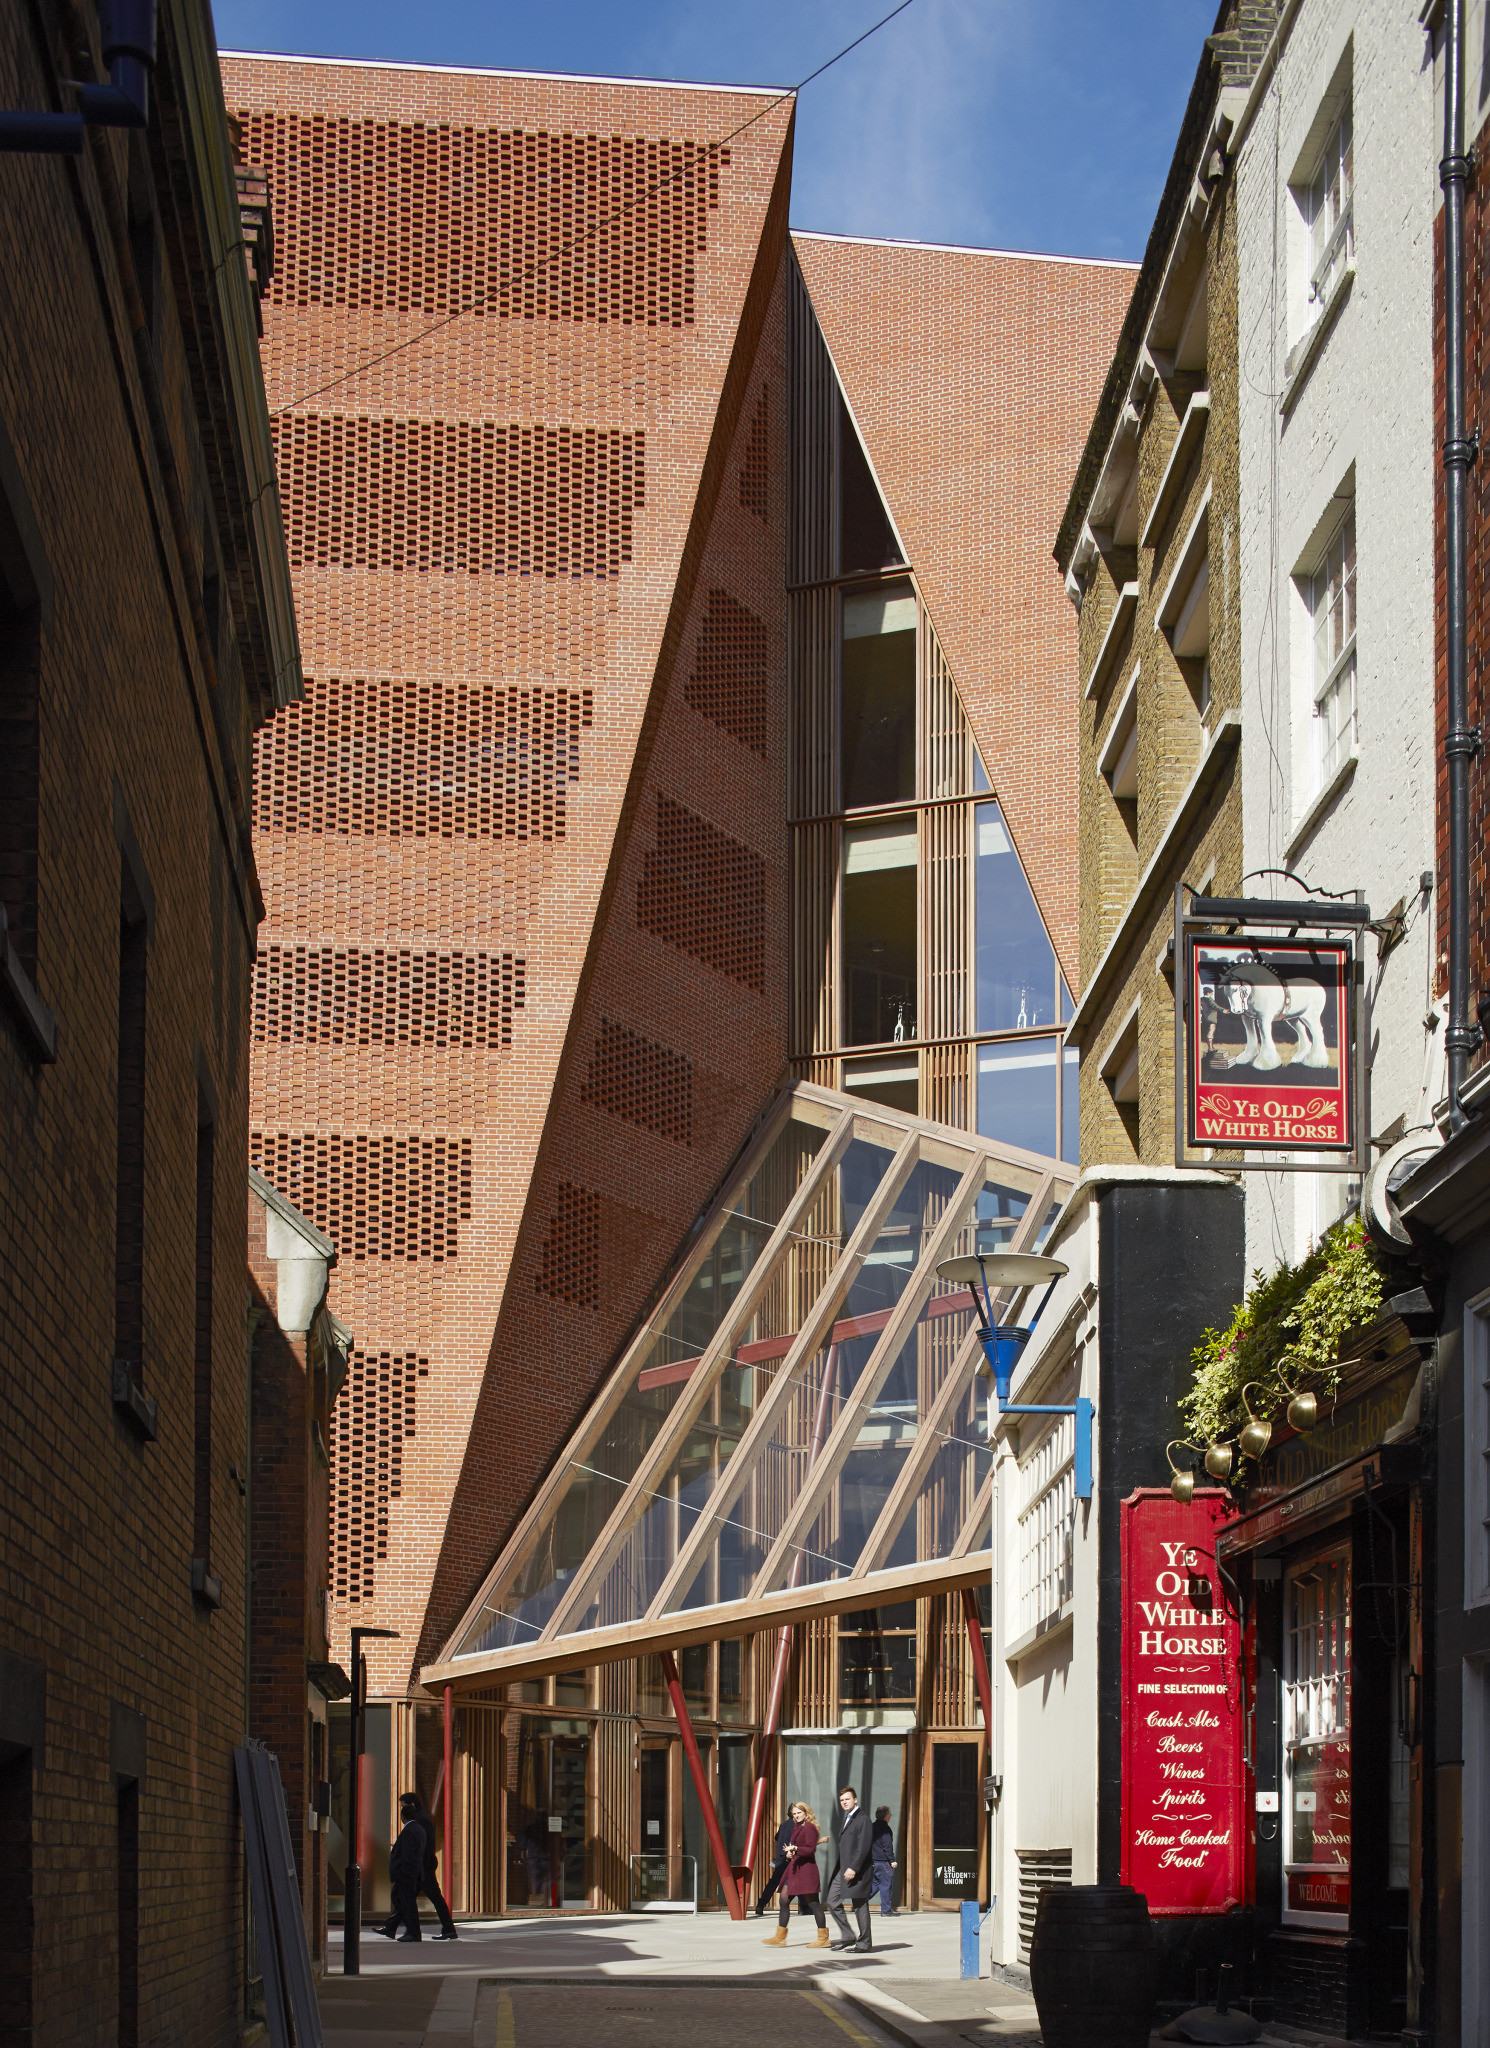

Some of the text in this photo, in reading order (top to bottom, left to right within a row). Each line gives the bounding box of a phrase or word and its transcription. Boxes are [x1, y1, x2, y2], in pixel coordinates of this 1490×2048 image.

[1233, 1100, 1306, 1119] YE OLD
[1201, 1118, 1338, 1139] WHITE HORSE
[1160, 1542, 1198, 1567] YE
[1155, 1571, 1212, 1596] OLD
[1137, 1601, 1227, 1627] WHITE
[1139, 1631, 1228, 1655] HORSE
[1138, 1683, 1228, 1694] FINE SELECTION OF
[1144, 1709, 1220, 1728] Cask Ales
[1156, 1734, 1204, 1753] Beers
[1159, 1762, 1205, 1779] Wines
[1152, 1788, 1206, 1811] Spirits
[1135, 1829, 1230, 1846] Home Cooked
[1299, 1883, 1338, 1902] WELCOME
